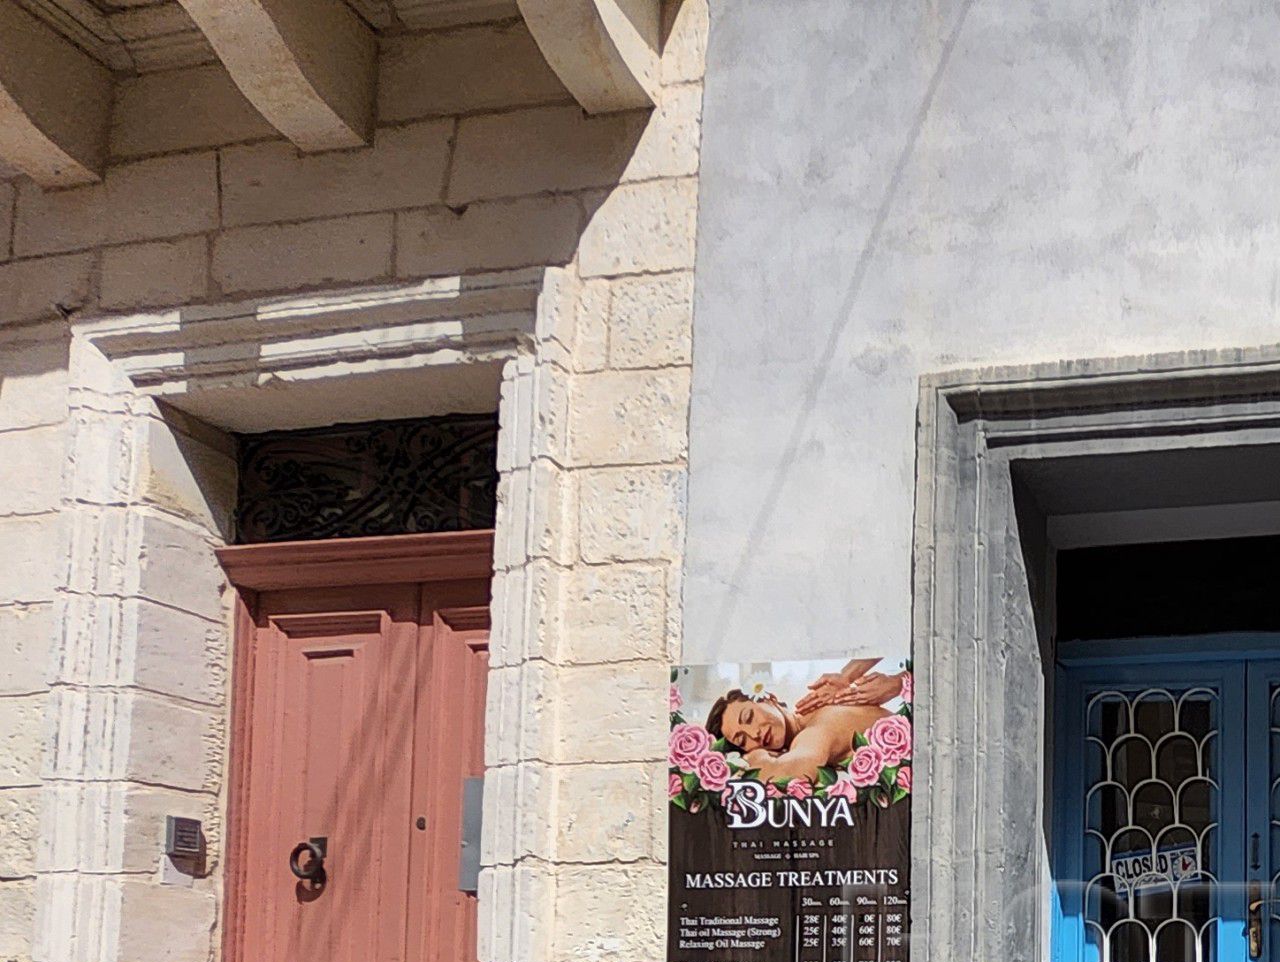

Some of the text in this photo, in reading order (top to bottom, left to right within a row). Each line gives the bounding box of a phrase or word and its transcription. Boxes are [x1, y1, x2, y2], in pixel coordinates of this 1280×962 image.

[726, 781, 854, 828] BUNYA
[773, 839, 834, 848] MASSAGE
[685, 869, 898, 889] MASSAGE TREATMENTS
[680, 916, 698, 925] Thai
[699, 915, 742, 925] Traditional
[744, 915, 779, 926] Massage
[680, 928, 697, 937] Thai
[712, 928, 746, 938] Massage
[747, 927, 781, 938] (Strong)
[679, 939, 714, 950] Relaxing
[716, 938, 729, 948] Oil
[731, 939, 765, 950] Massage
